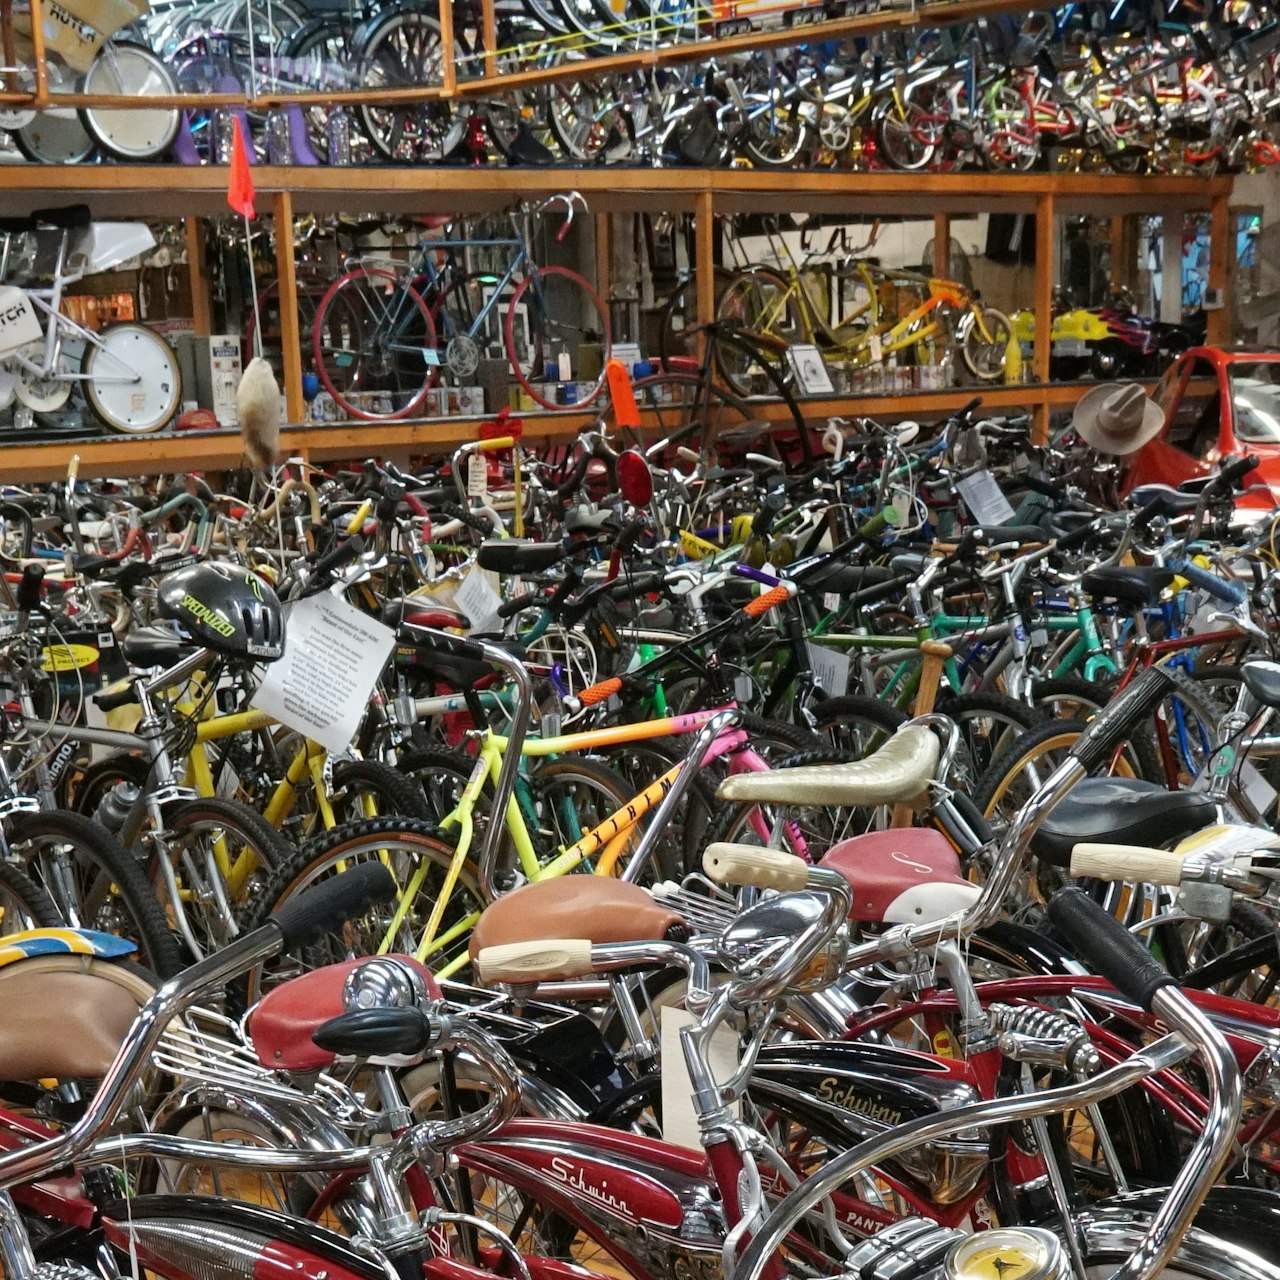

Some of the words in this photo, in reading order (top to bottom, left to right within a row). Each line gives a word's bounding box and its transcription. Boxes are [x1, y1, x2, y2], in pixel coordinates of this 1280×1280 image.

[180, 594, 236, 637] SPECIALIZED
[575, 776, 674, 859] EXTREM
[817, 1076, 903, 1128] Schwinn
[541, 1156, 634, 1216] Schwinn
[846, 1211, 886, 1234] PANT
